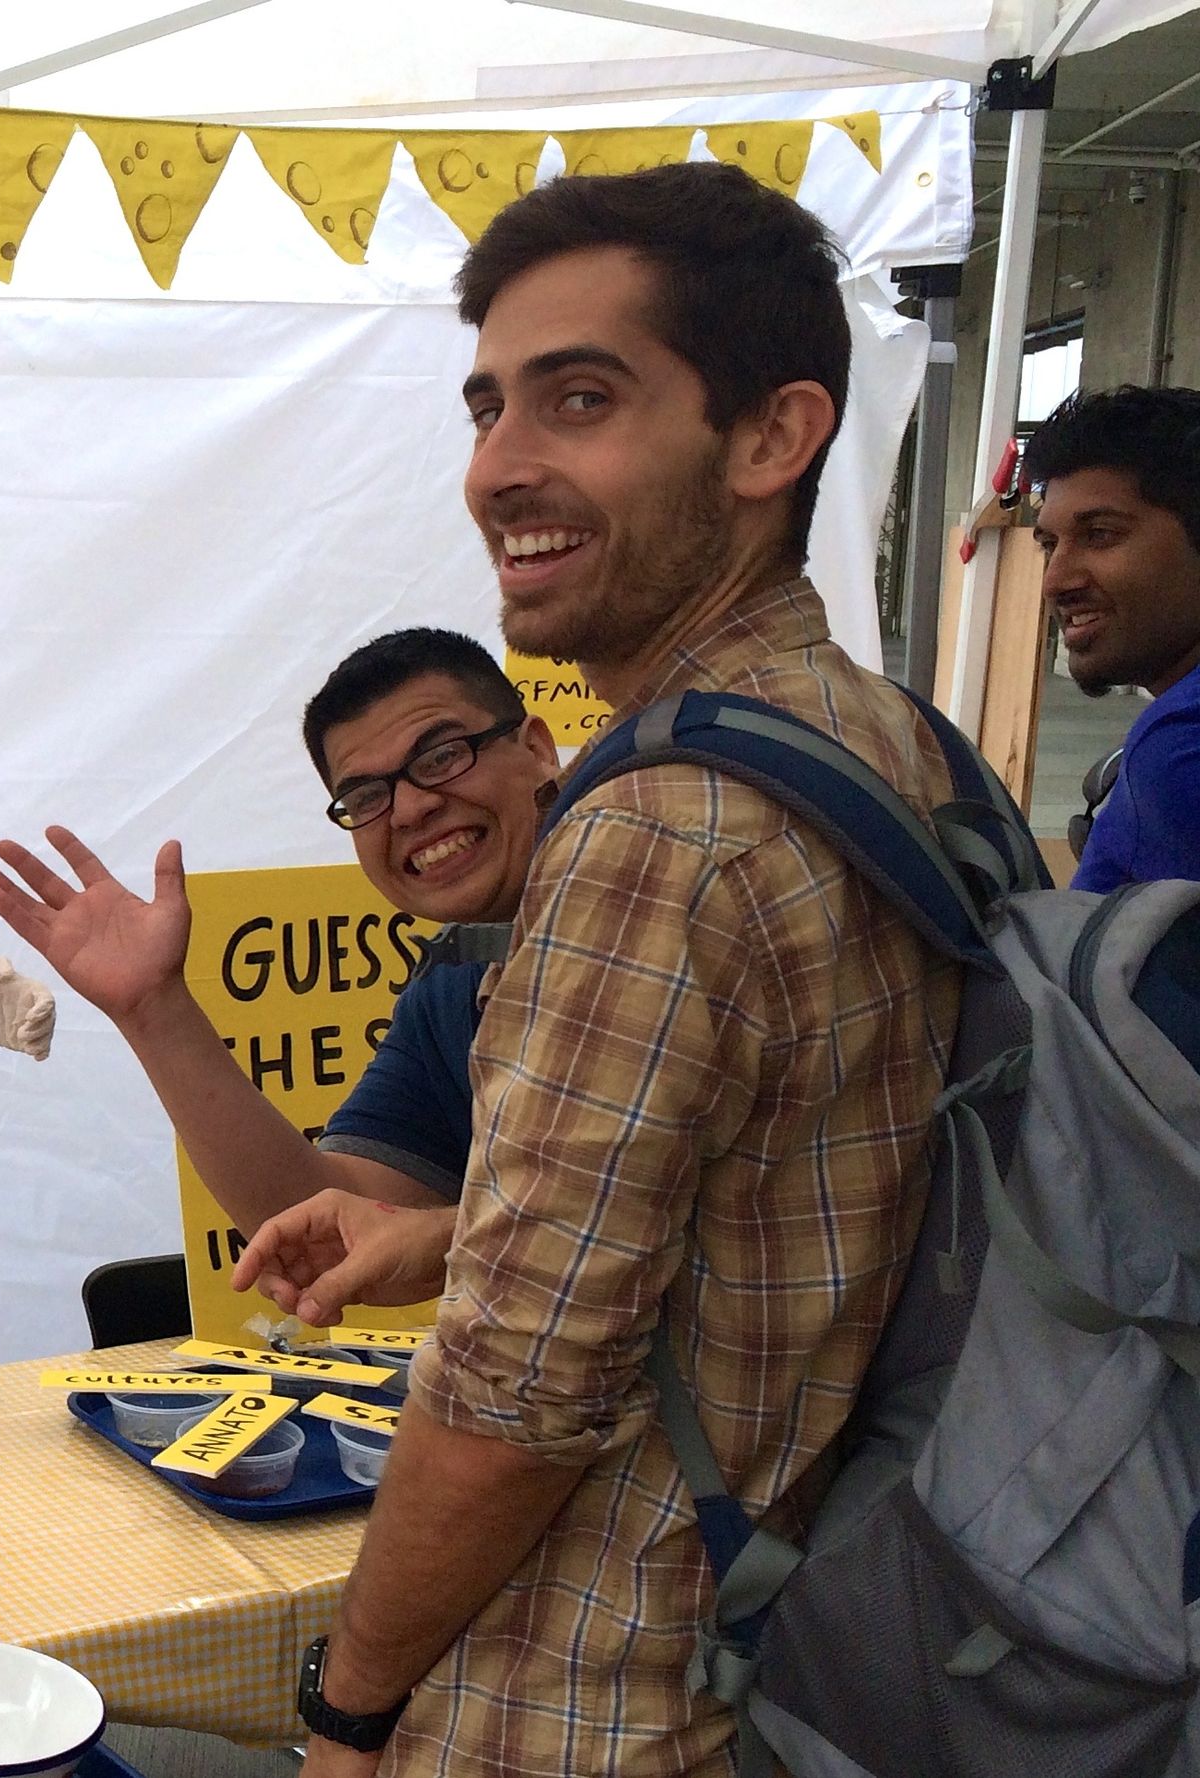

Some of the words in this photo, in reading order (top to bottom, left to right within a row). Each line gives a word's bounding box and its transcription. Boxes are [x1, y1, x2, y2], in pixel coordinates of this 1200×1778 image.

[514, 679, 605, 702] SFMI
[221, 911, 416, 1002] GUESS
[211, 1349, 334, 1371] ASH
[64, 1374, 224, 1388] cultures
[181, 1396, 267, 1462] ANNATO
